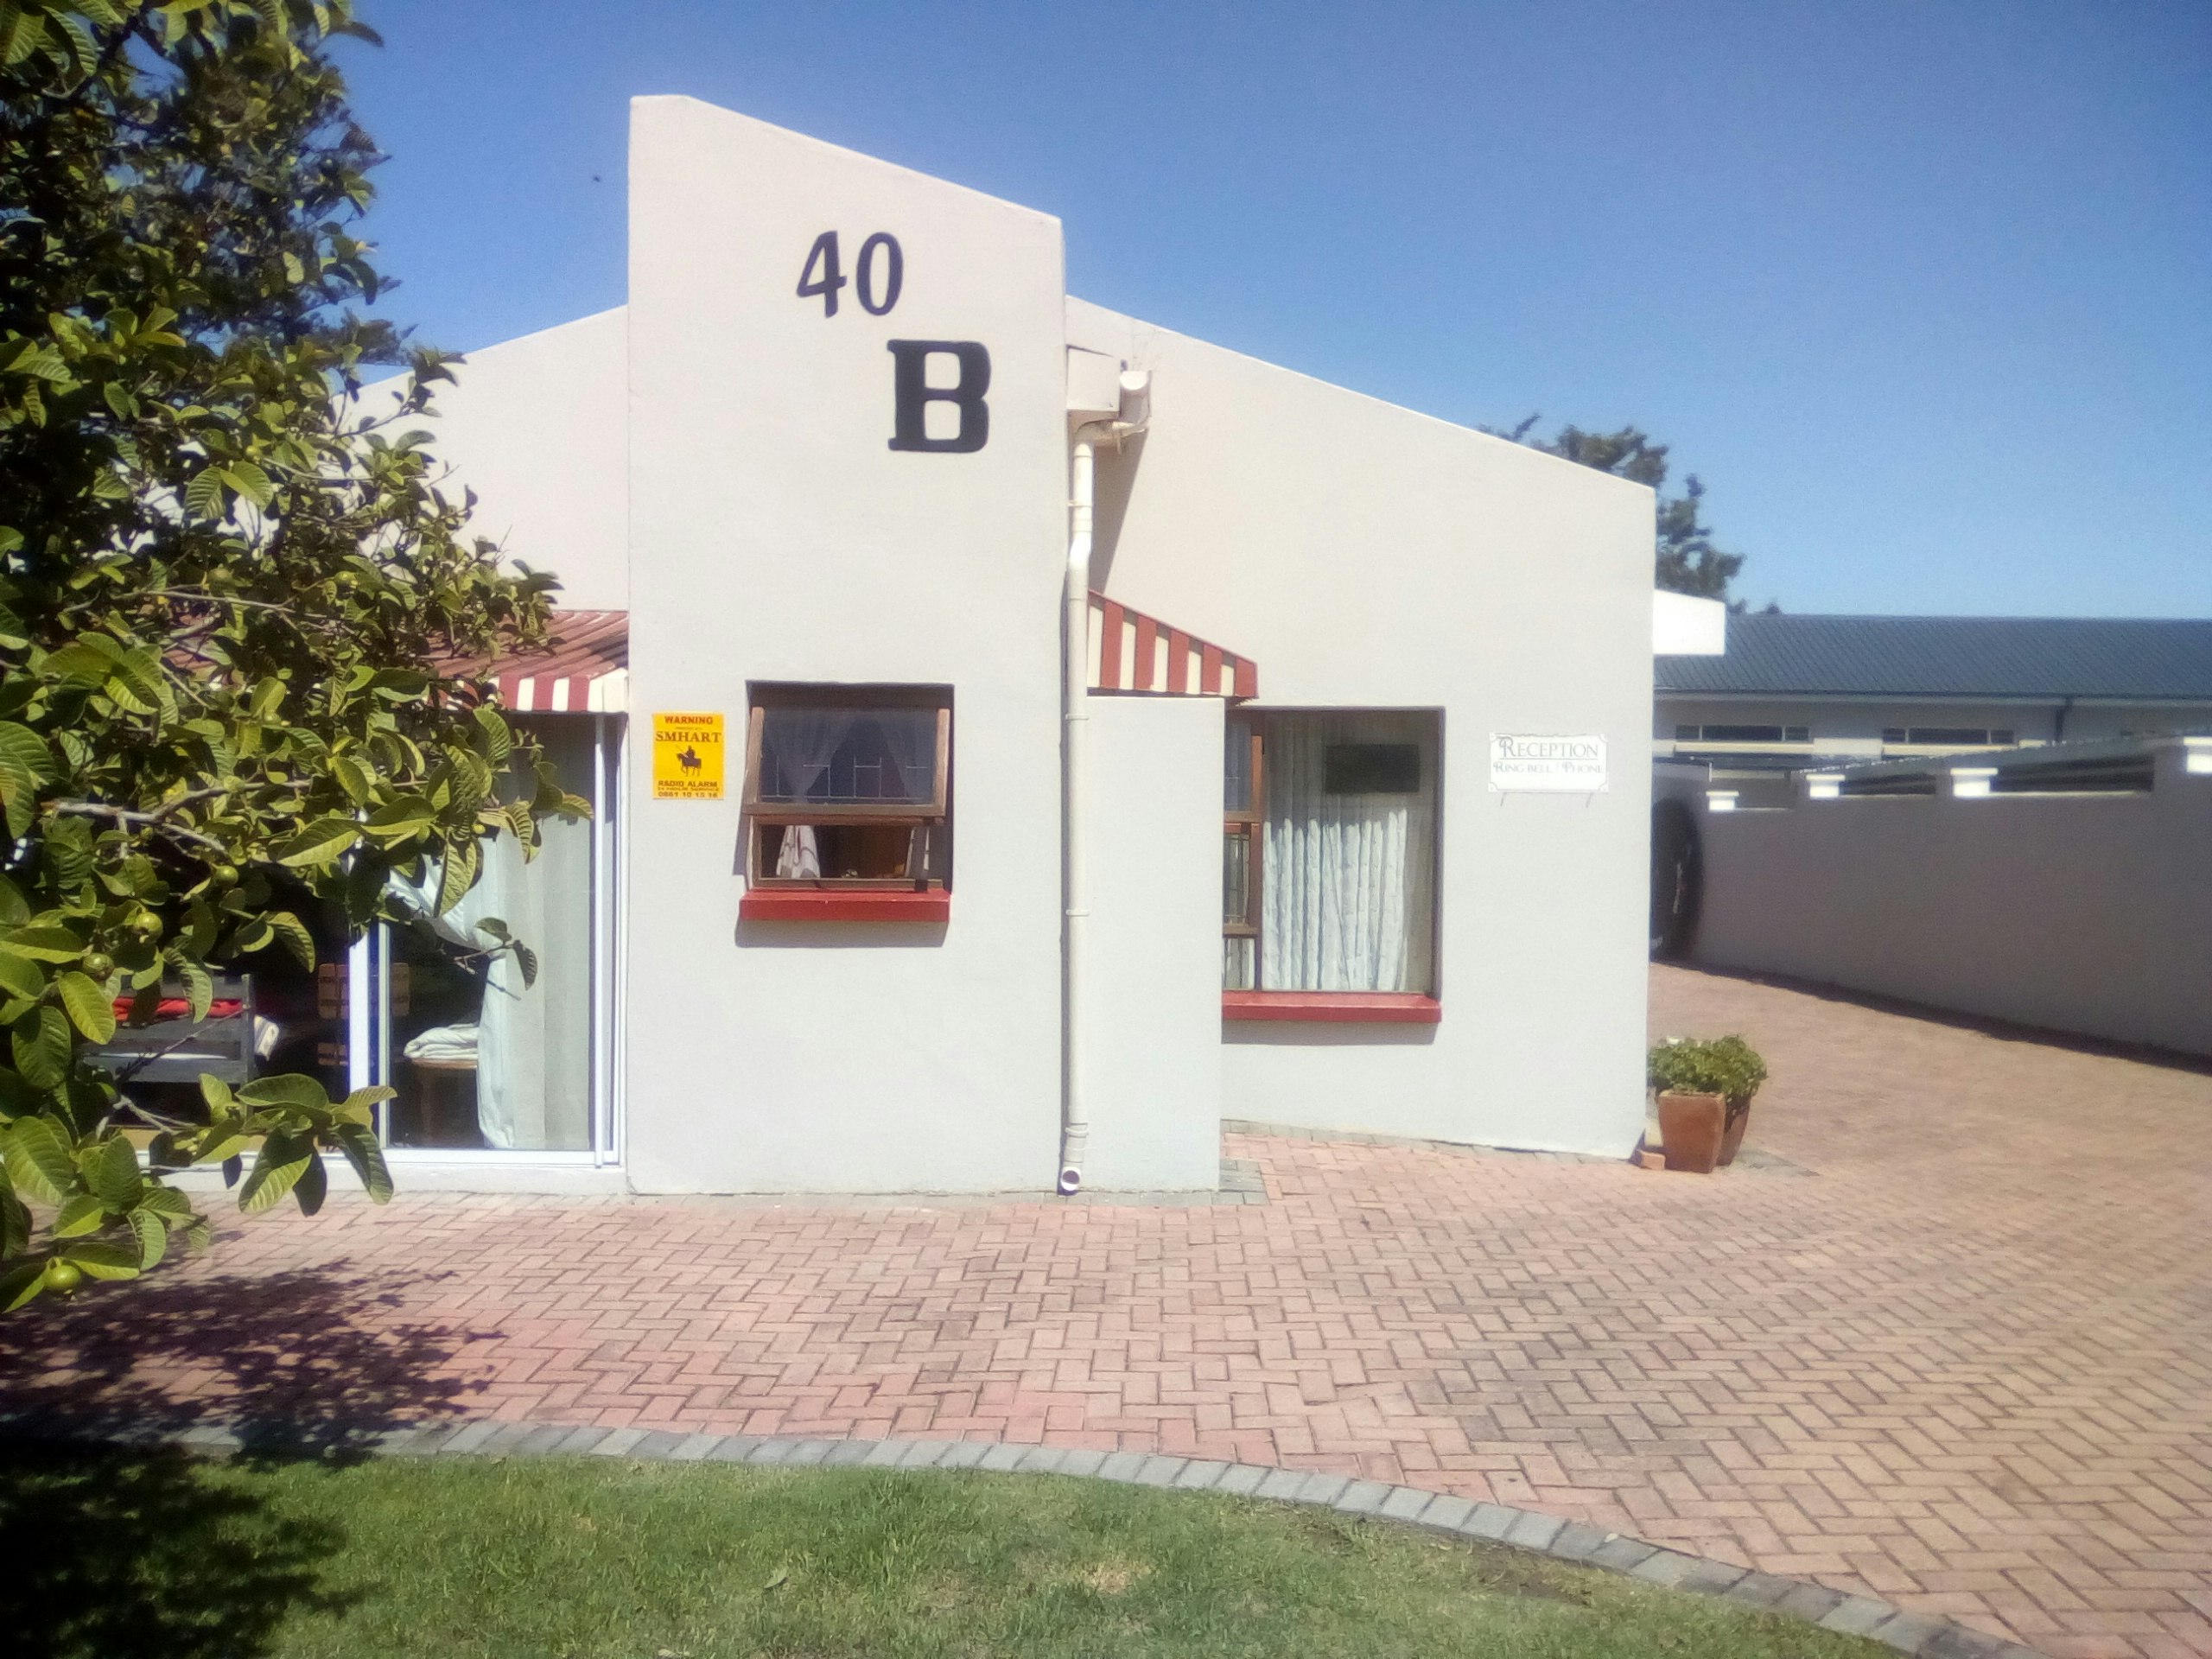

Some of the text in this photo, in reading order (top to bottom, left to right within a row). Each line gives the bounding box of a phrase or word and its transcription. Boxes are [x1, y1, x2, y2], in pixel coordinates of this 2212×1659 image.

[797, 230, 904, 319] 40
[887, 339, 991, 454] B
[664, 715, 714, 724] WARNING
[655, 731, 722, 743] SMHART
[1497, 735, 1599, 758] RECEPTION
